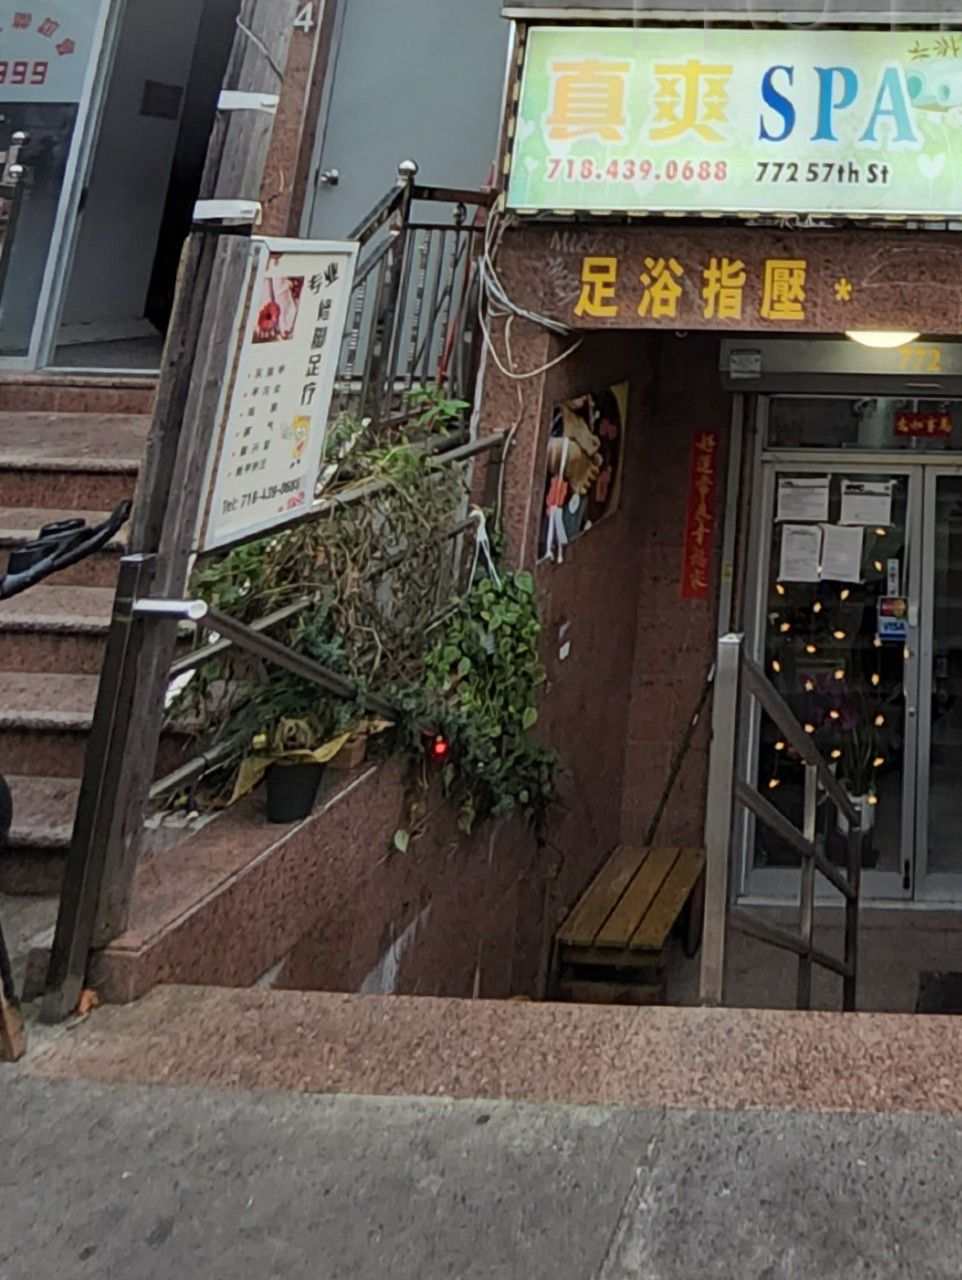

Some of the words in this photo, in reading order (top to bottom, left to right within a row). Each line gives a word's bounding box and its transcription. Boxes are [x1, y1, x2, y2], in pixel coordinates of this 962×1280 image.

[545, 59, 734, 141] 真爽
[758, 64, 919, 143] SPA
[547, 158, 729, 183] 718.439.0688
[755, 161, 799, 183] 772
[805, 161, 862, 183] 57th
[865, 162, 890, 184] St
[574, 257, 806, 320] 足浴指壓
[900, 347, 942, 373] 772
